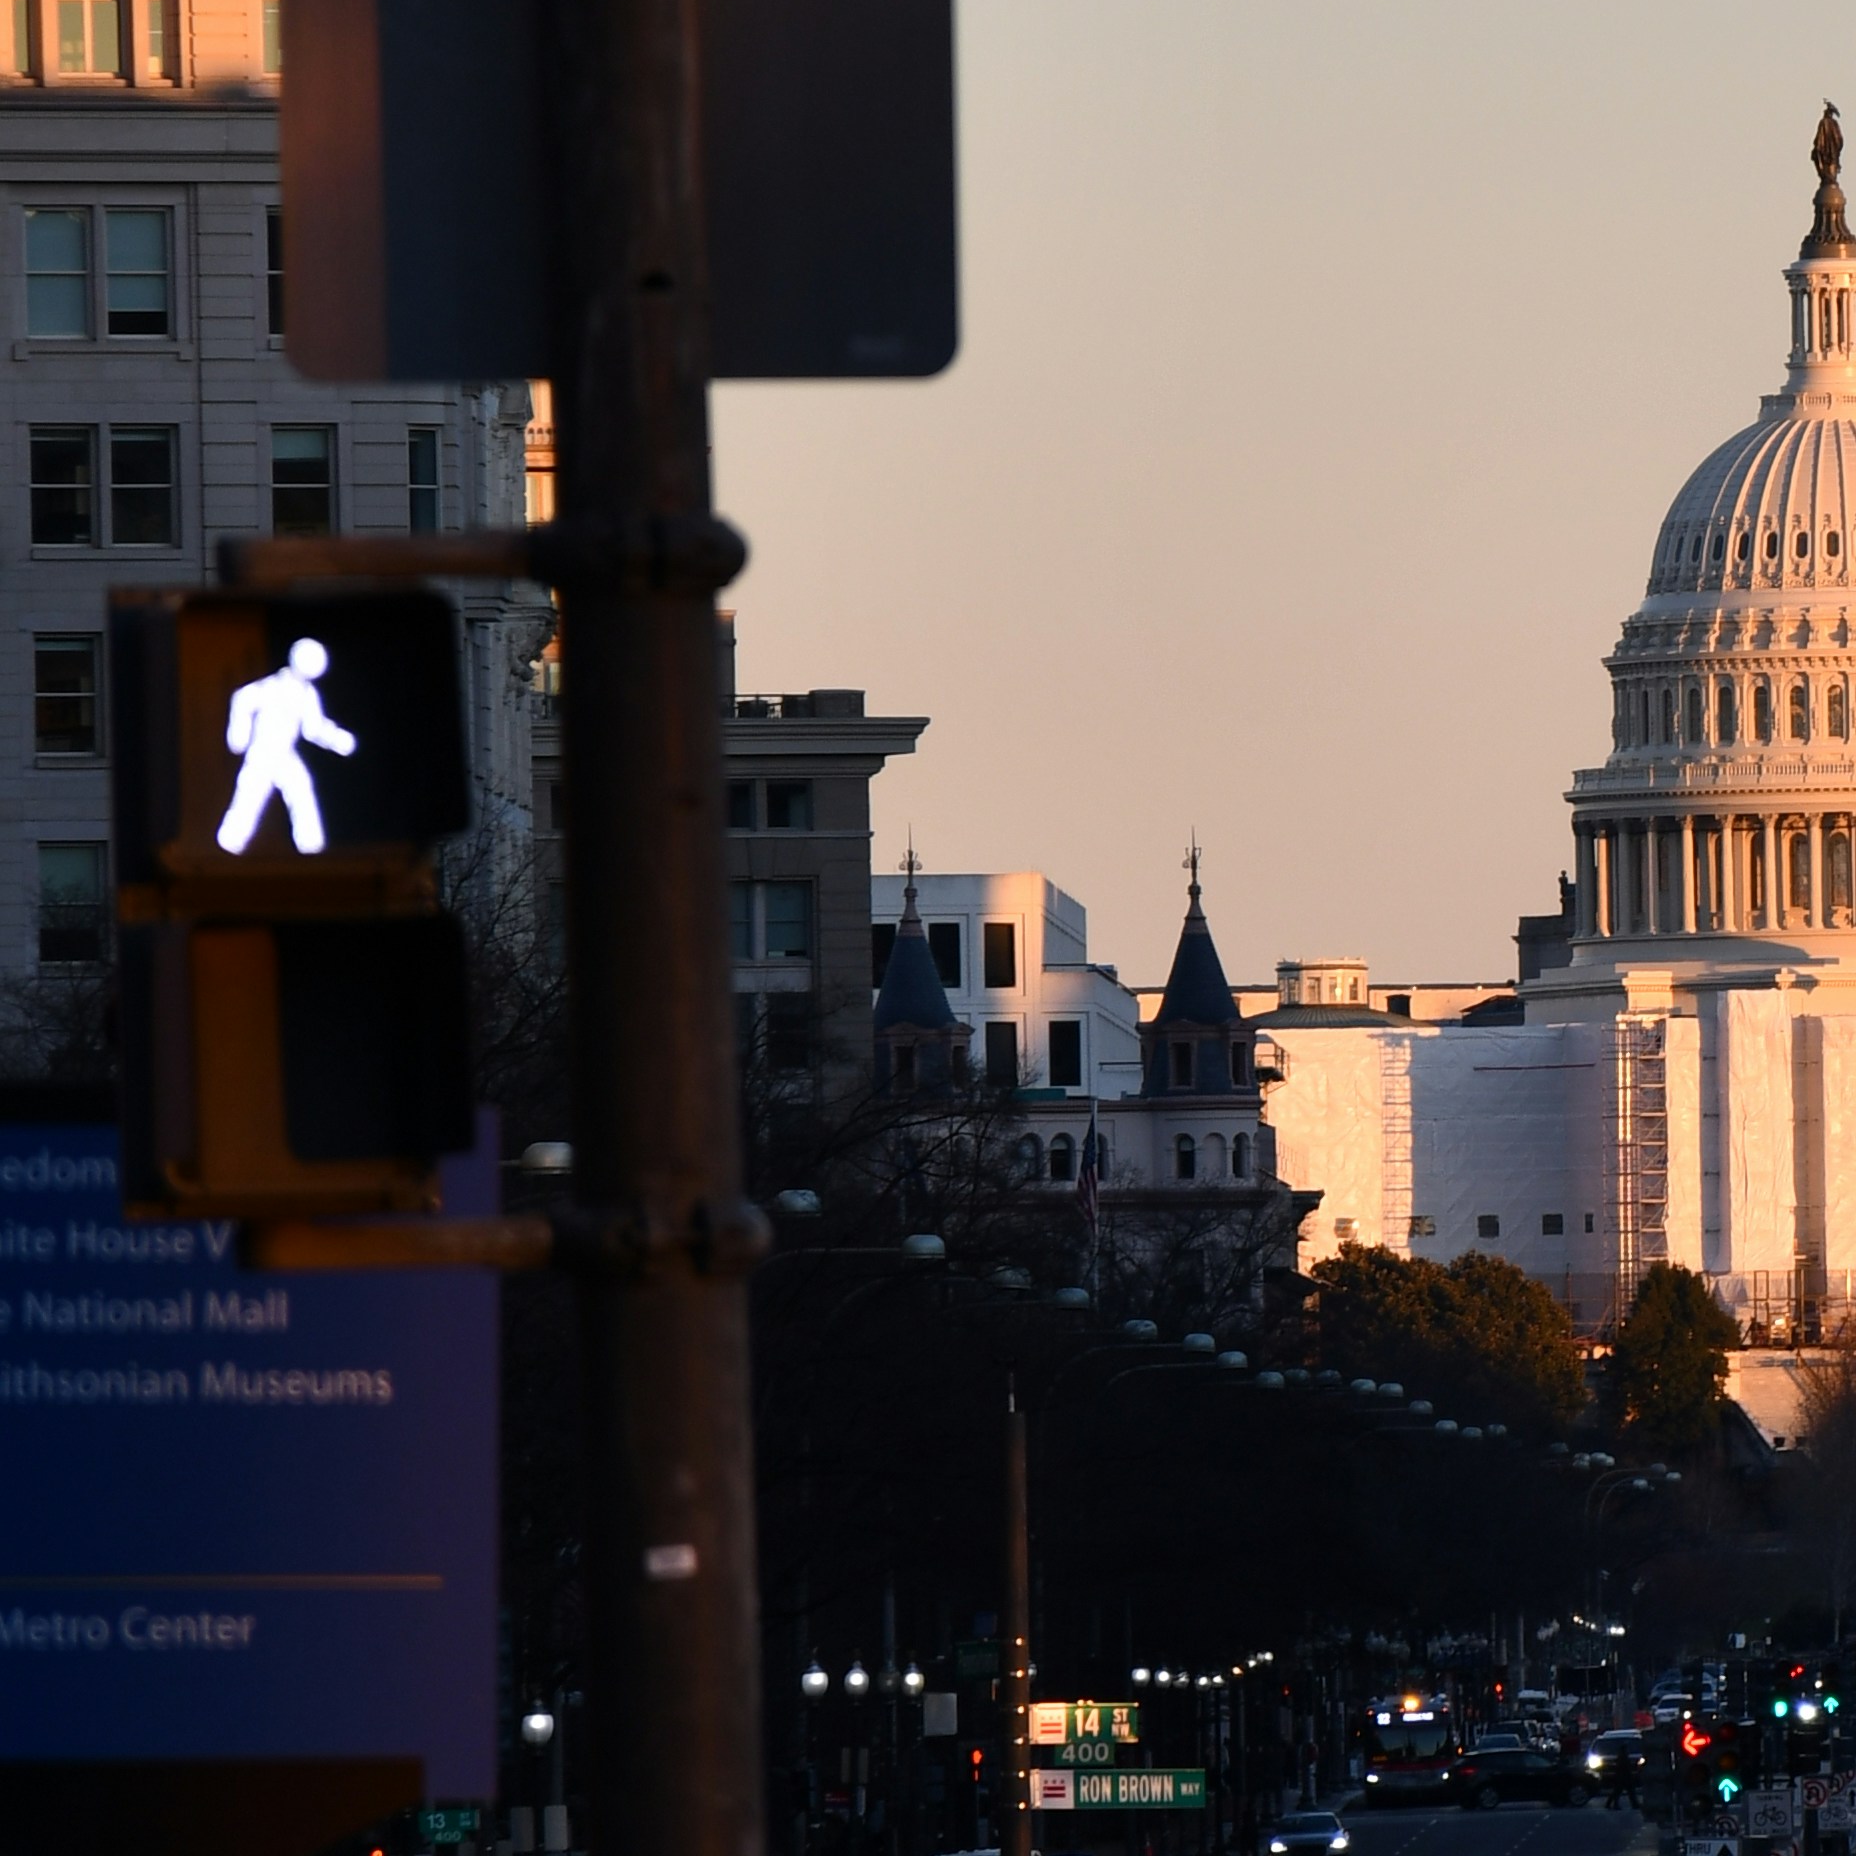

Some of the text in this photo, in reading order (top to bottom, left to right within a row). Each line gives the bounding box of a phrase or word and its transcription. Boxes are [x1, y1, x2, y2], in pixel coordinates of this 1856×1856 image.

[0, 1220, 57, 1262] ite
[66, 1219, 197, 1262] House
[20, 1289, 193, 1333] National
[204, 1289, 290, 1333] Mall
[200, 1361, 393, 1405] Museums
[119, 1605, 256, 1650] Center
[1075, 1708, 1128, 1737] 14 ST
[1062, 1743, 1109, 1762] 400
[1080, 1775, 1200, 1802] RON BROWN WAY
[427, 1813, 446, 1829] 13
[435, 1830, 462, 1842] 400
